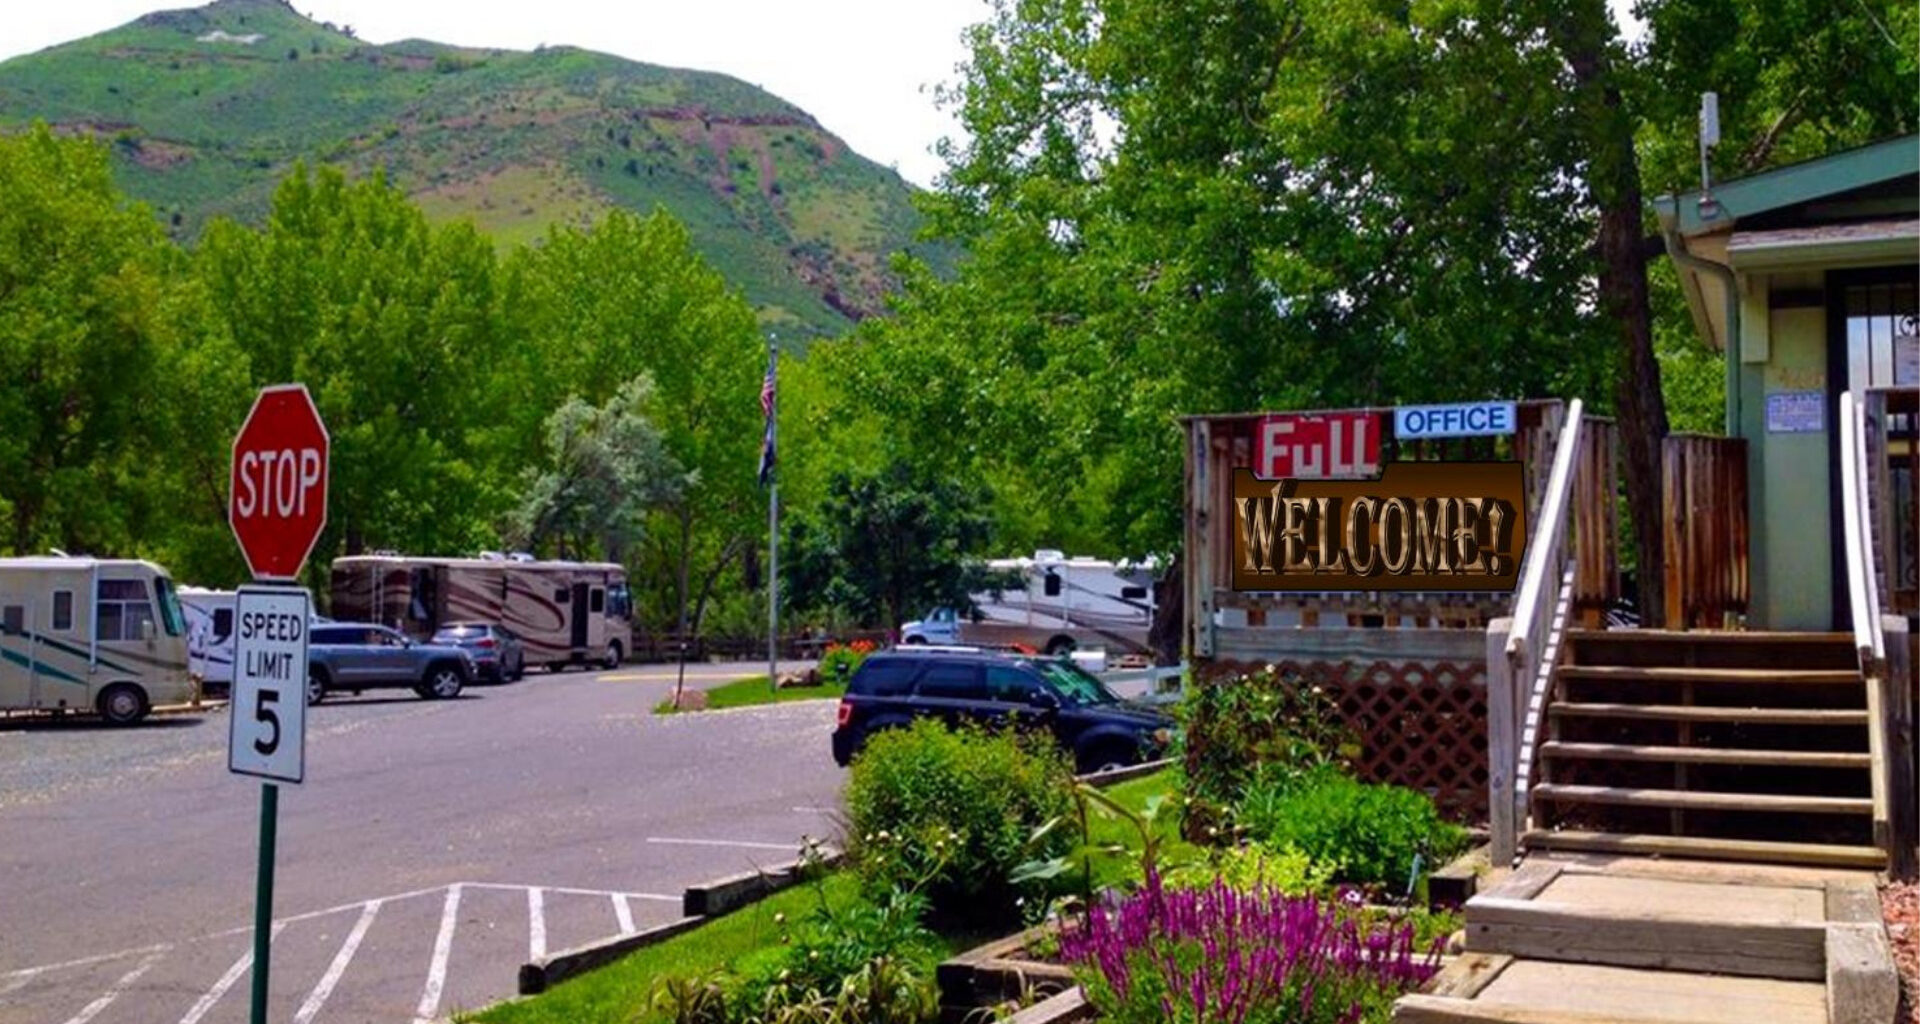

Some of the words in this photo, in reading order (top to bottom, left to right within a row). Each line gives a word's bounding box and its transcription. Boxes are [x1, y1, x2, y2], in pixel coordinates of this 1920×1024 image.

[1404, 406, 1506, 434] OFFICE
[237, 448, 320, 518] STOP
[1235, 481, 1508, 576] WELCOME!
[241, 612, 301, 642] SPEED
[246, 652, 293, 680] LIMIT
[254, 689, 281, 756] 5
